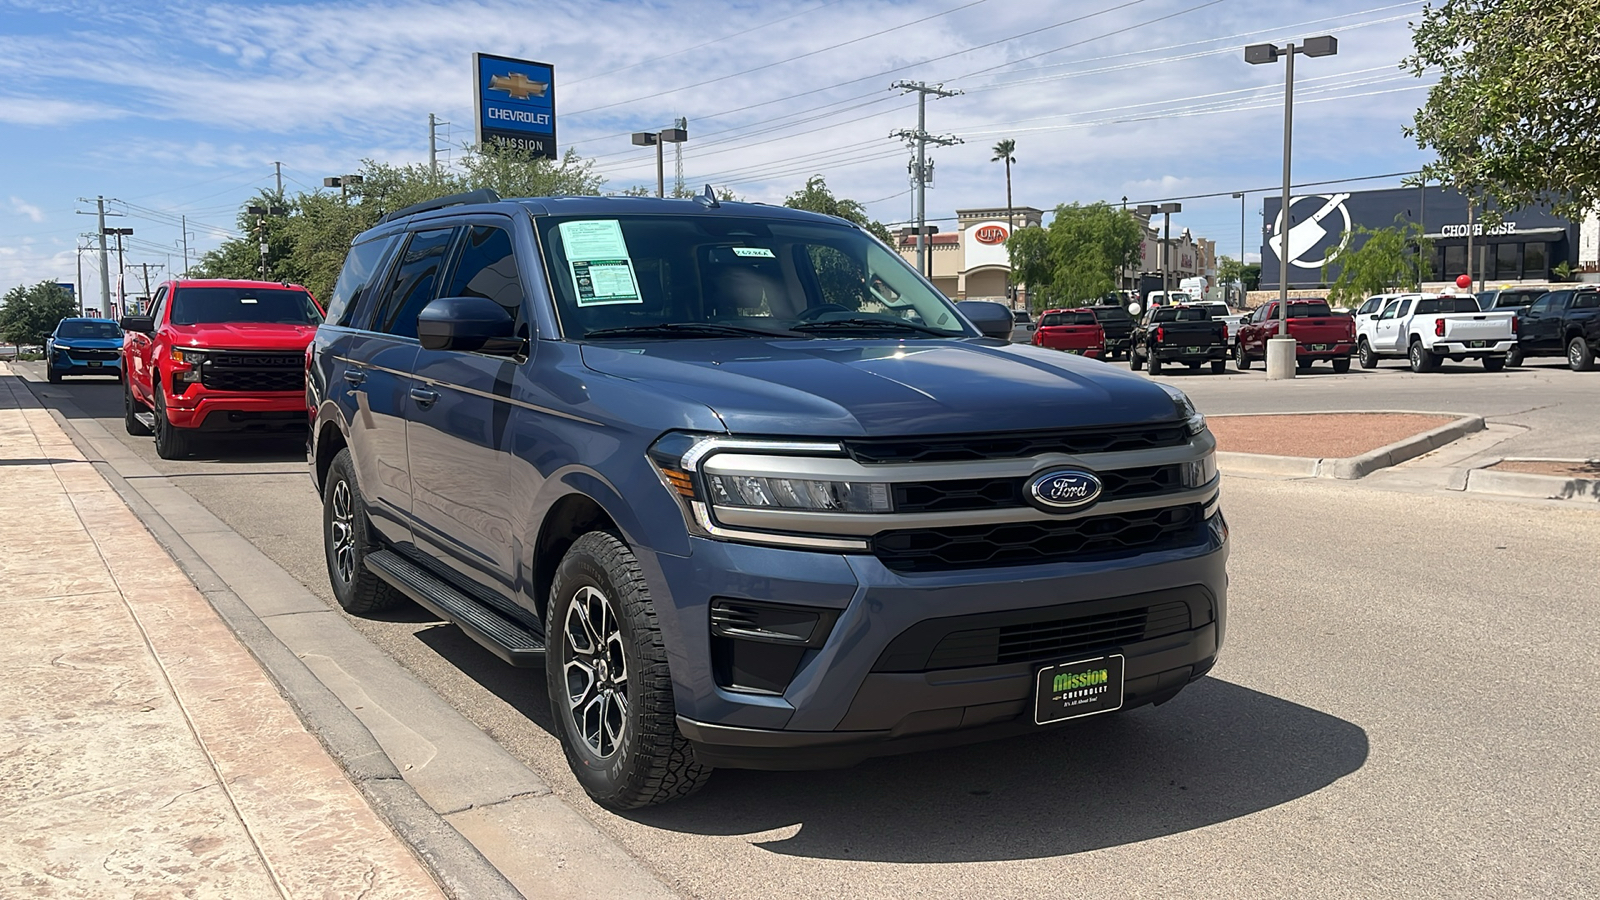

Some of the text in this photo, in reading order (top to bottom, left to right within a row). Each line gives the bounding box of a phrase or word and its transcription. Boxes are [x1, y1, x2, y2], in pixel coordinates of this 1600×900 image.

[488, 107, 550, 125] CHEVROLET
[980, 229, 1004, 238] ULTA
[1441, 221, 1516, 237] CHOHUSE
[1051, 478, 1087, 499] Ford
[1053, 669, 1107, 692] Mission
[1063, 686, 1107, 700] CHEVROLET
